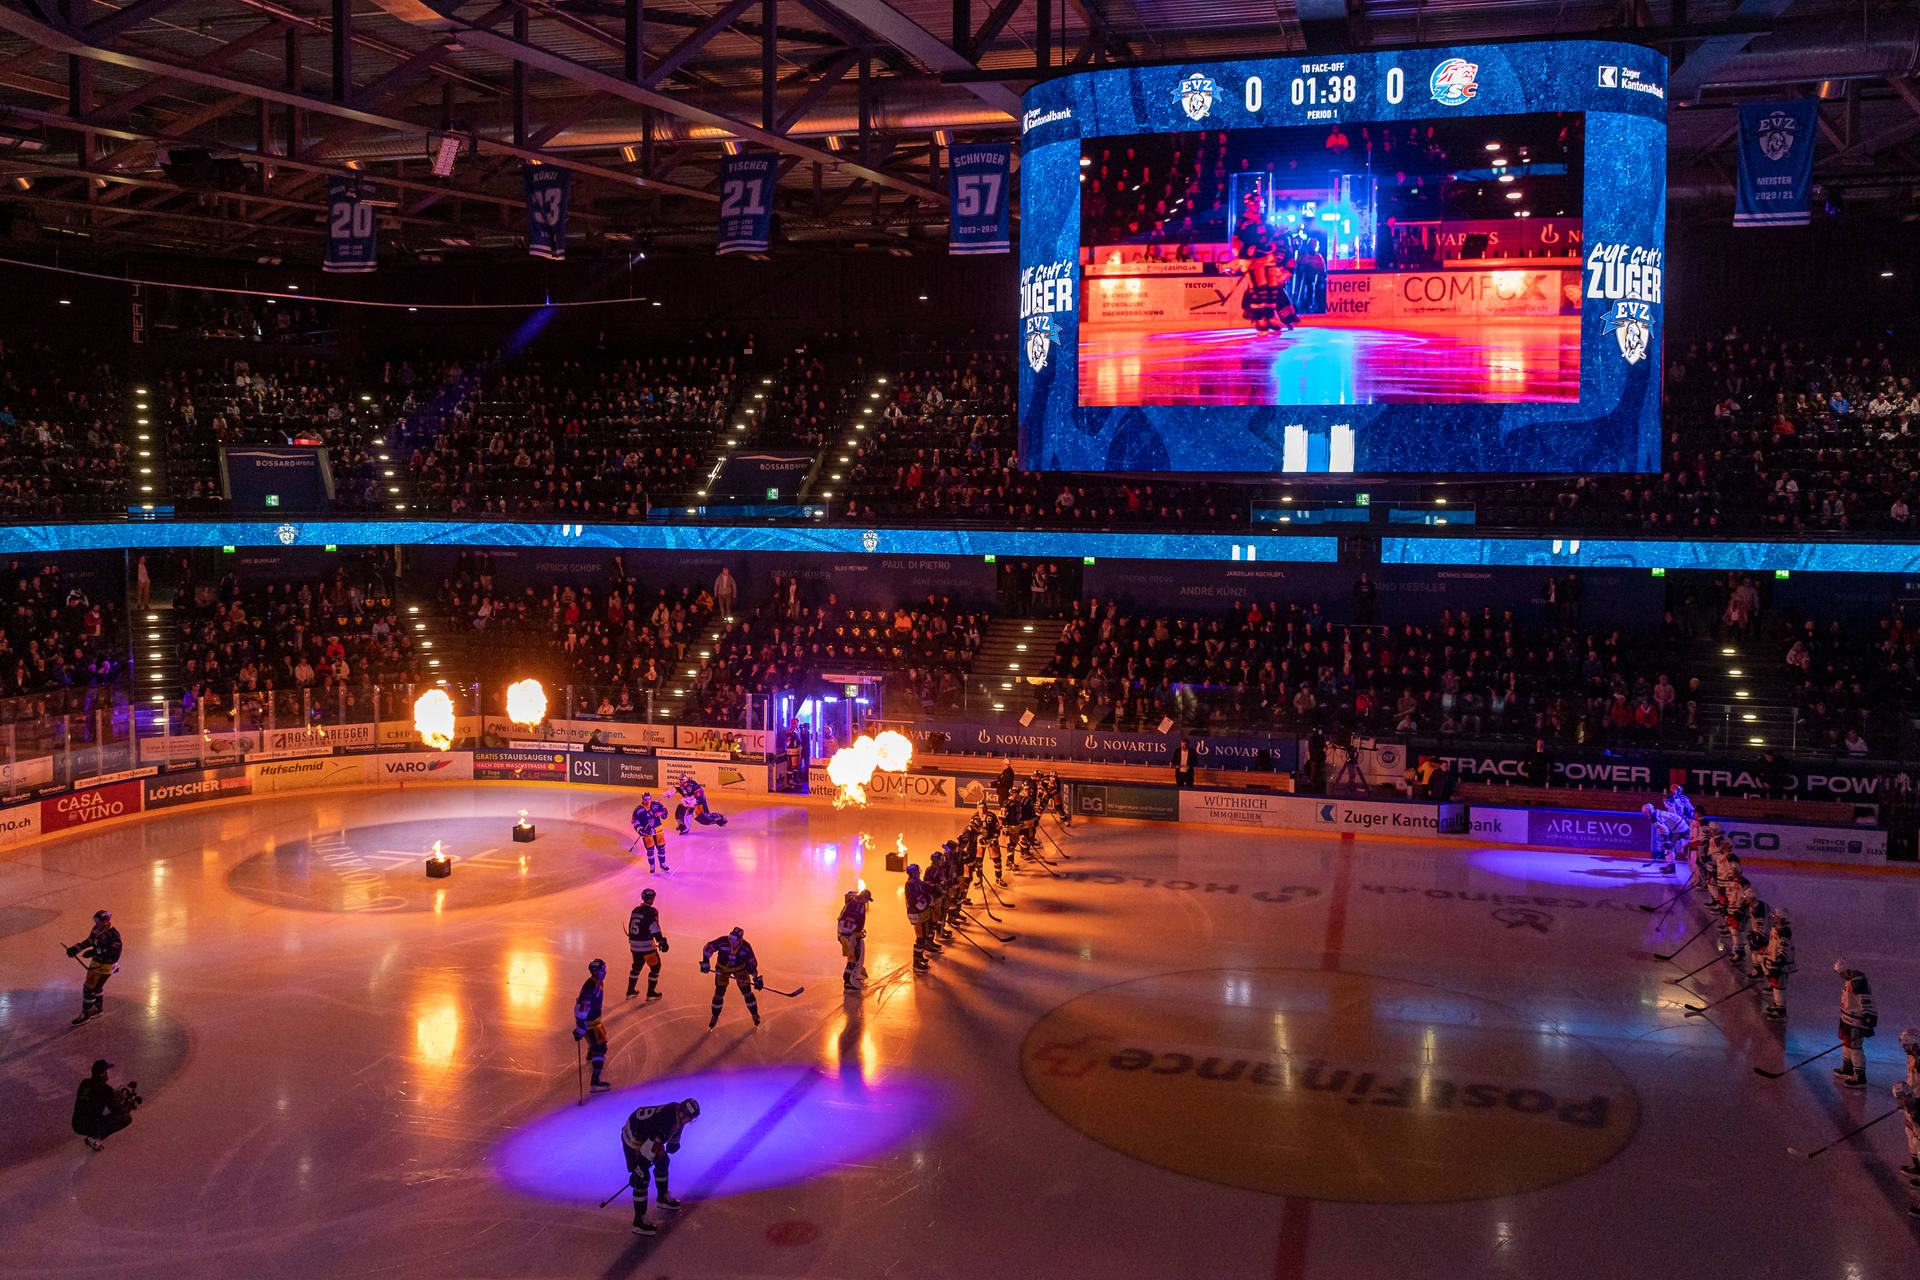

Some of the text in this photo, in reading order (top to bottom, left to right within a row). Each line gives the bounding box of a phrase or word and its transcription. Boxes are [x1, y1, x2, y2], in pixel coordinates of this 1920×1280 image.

[1302, 62, 1345, 74] TO FACE-OFF
[1622, 67, 1641, 79] Zuger
[1181, 79, 1213, 93] EVZ
[1291, 74, 1356, 106] 01:38
[1386, 67, 1404, 105] 0
[1430, 83, 1479, 99] ZSC
[1245, 76, 1262, 112] 0
[1307, 109, 1338, 120] PERIOD 1
[1758, 117, 1796, 131] EVZ
[728, 160, 768, 173] FISCHER
[953, 152, 1005, 167] SCHNYDER
[720, 179, 765, 218] 21
[957, 173, 1003, 217] 57
[330, 201, 372, 239] 20
[1586, 261, 1662, 305] ZUGER
[1614, 301, 1650, 320] EVZ
[1026, 315, 1051, 334] EVZ
[882, 560, 950, 570] PAUL DI PIETRO
[996, 734, 1057, 747] NOVARTIS
[1103, 739, 1167, 753] NOVARTIS
[499, 753, 553, 762] STAUBSAUGEN
[260, 761, 324, 776] Hufschmid
[385, 761, 427, 774] VARO
[574, 760, 600, 777] CSL
[620, 763, 643, 772] Partner
[810, 771, 829, 781] tner
[871, 774, 947, 796] OMFOX
[57, 791, 105, 812] CASA
[1081, 796, 1103, 811] BG
[1204, 795, 1267, 809] WÜTHRICH
[79, 801, 124, 822] VINO
[1210, 810, 1261, 820] IMMOBILIEN
[1344, 810, 1388, 828] Zuger
[1546, 819, 1633, 837] ARLEWO
[1721, 830, 1780, 851] GO
[1108, 1046, 1612, 1129] PostFinance
